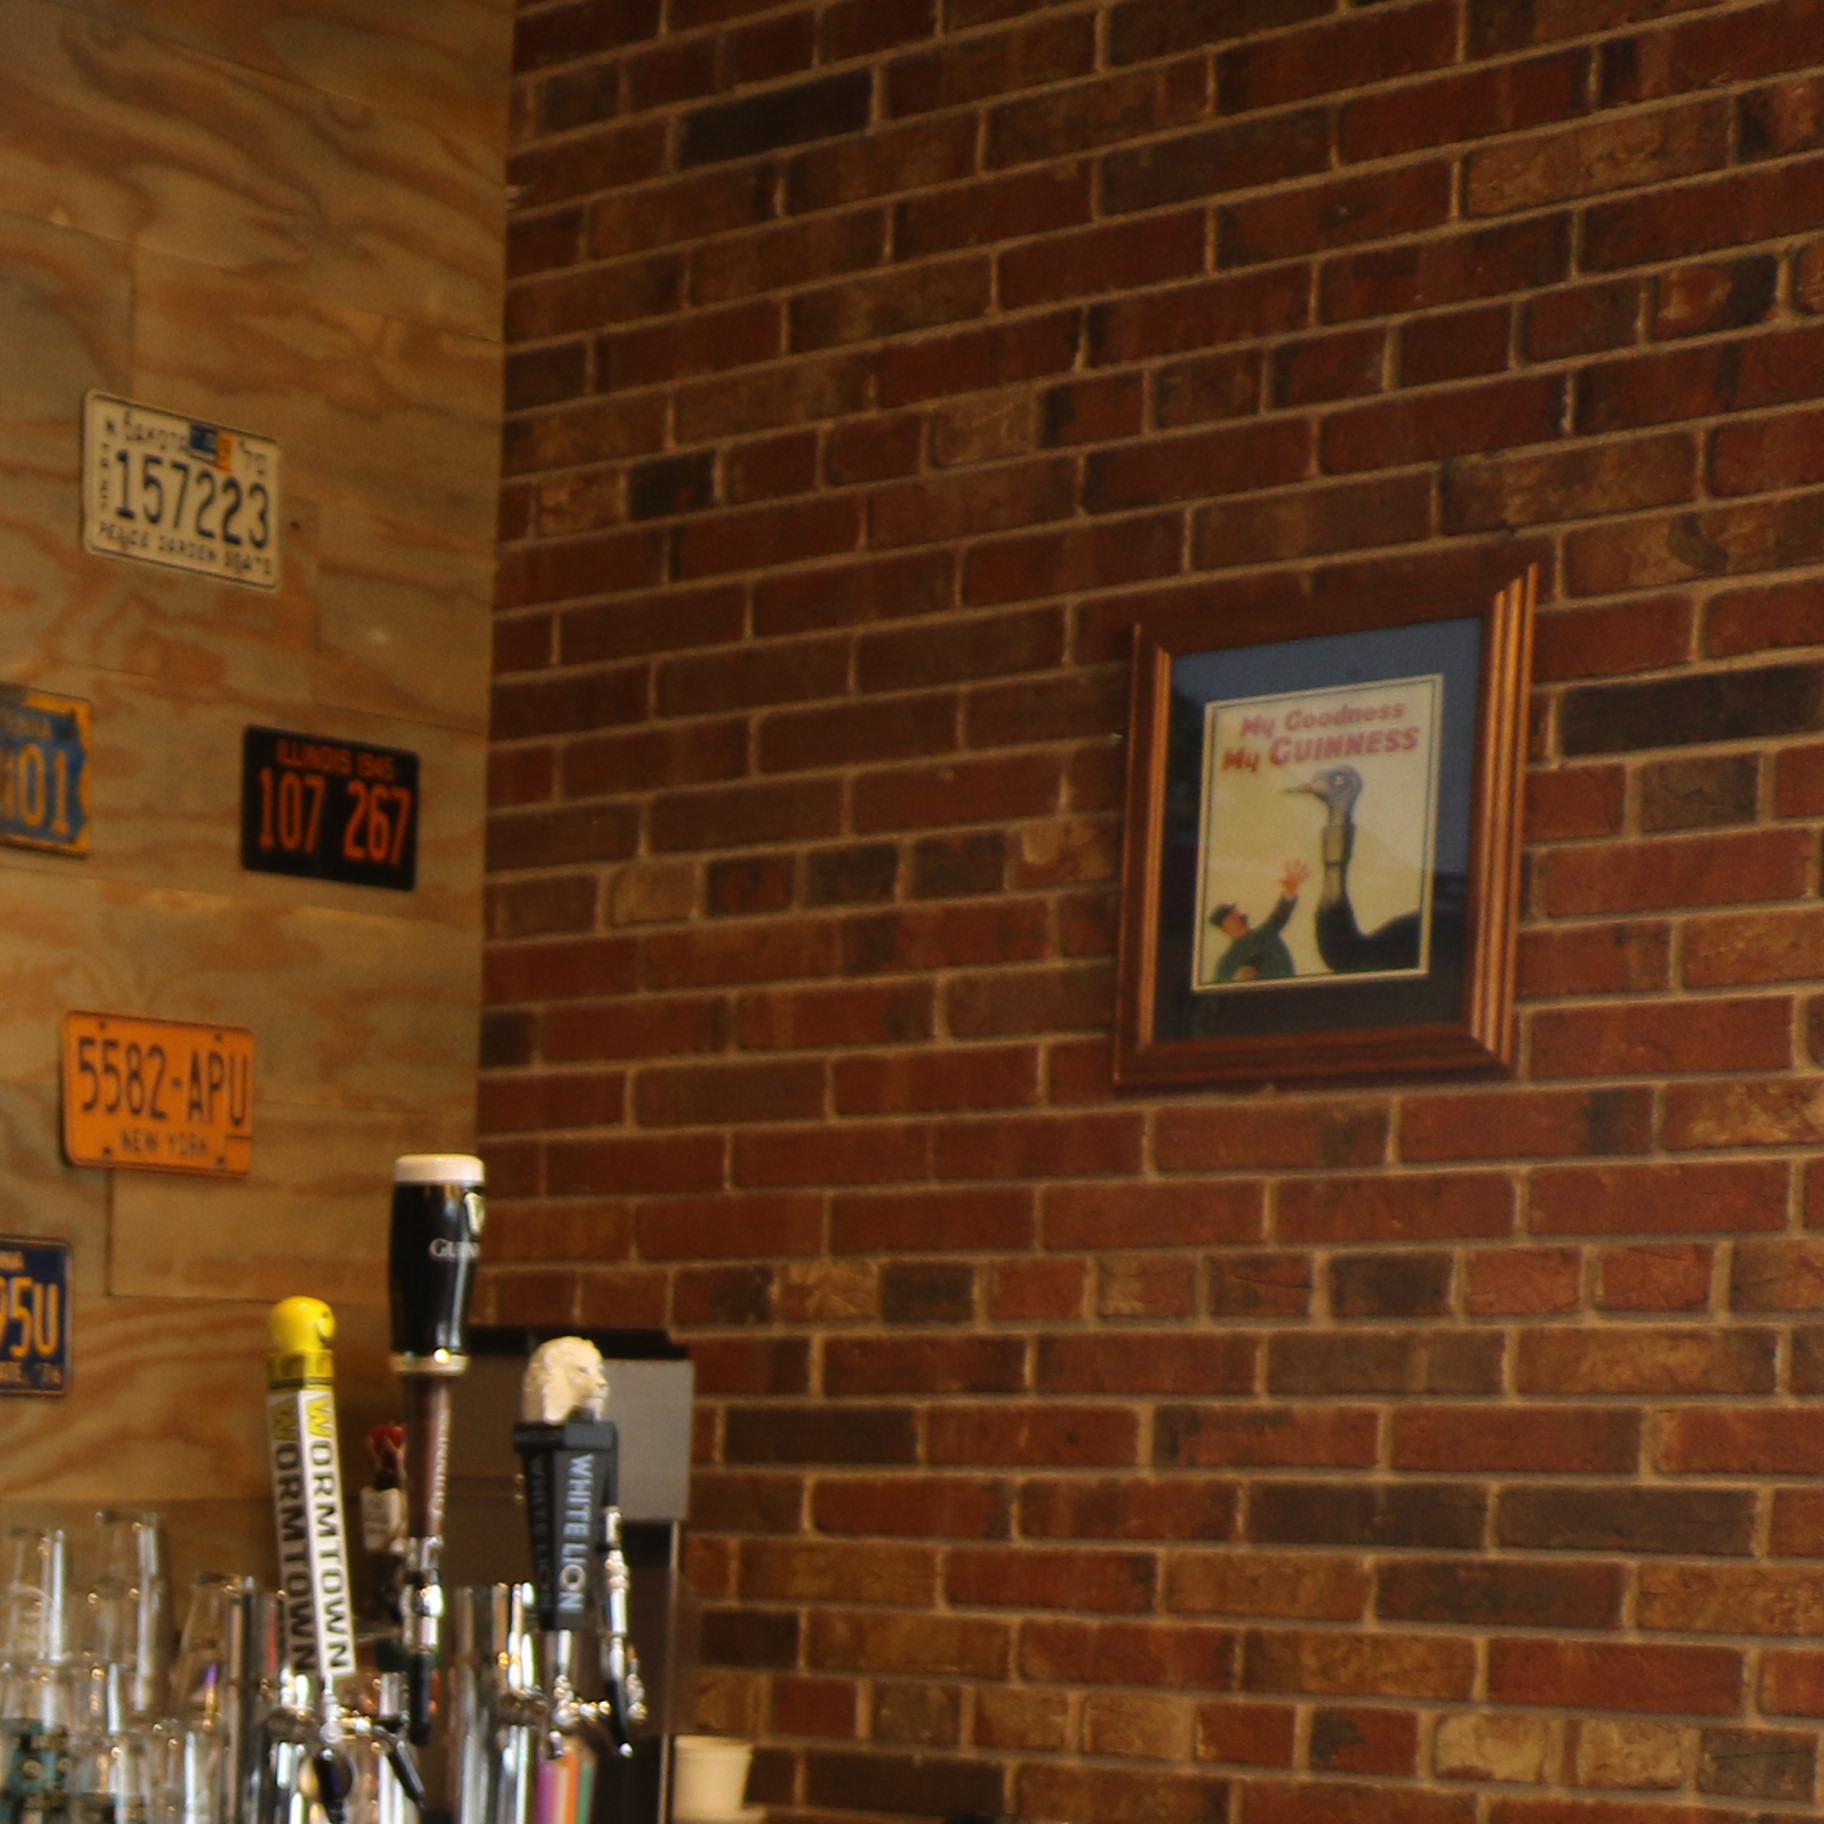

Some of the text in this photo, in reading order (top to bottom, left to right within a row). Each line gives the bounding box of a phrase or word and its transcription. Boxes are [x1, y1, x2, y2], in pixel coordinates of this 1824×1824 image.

[115, 449, 269, 549] 157223
[1221, 726, 1420, 773] My GUINNESS
[1285, 702, 1406, 733] Goodness
[259, 767, 412, 865] 107 267
[271, 1398, 318, 1675] WORMTOWN
[304, 1400, 348, 1677] WORMTOWN
[559, 1453, 596, 1617] WHITE LION
